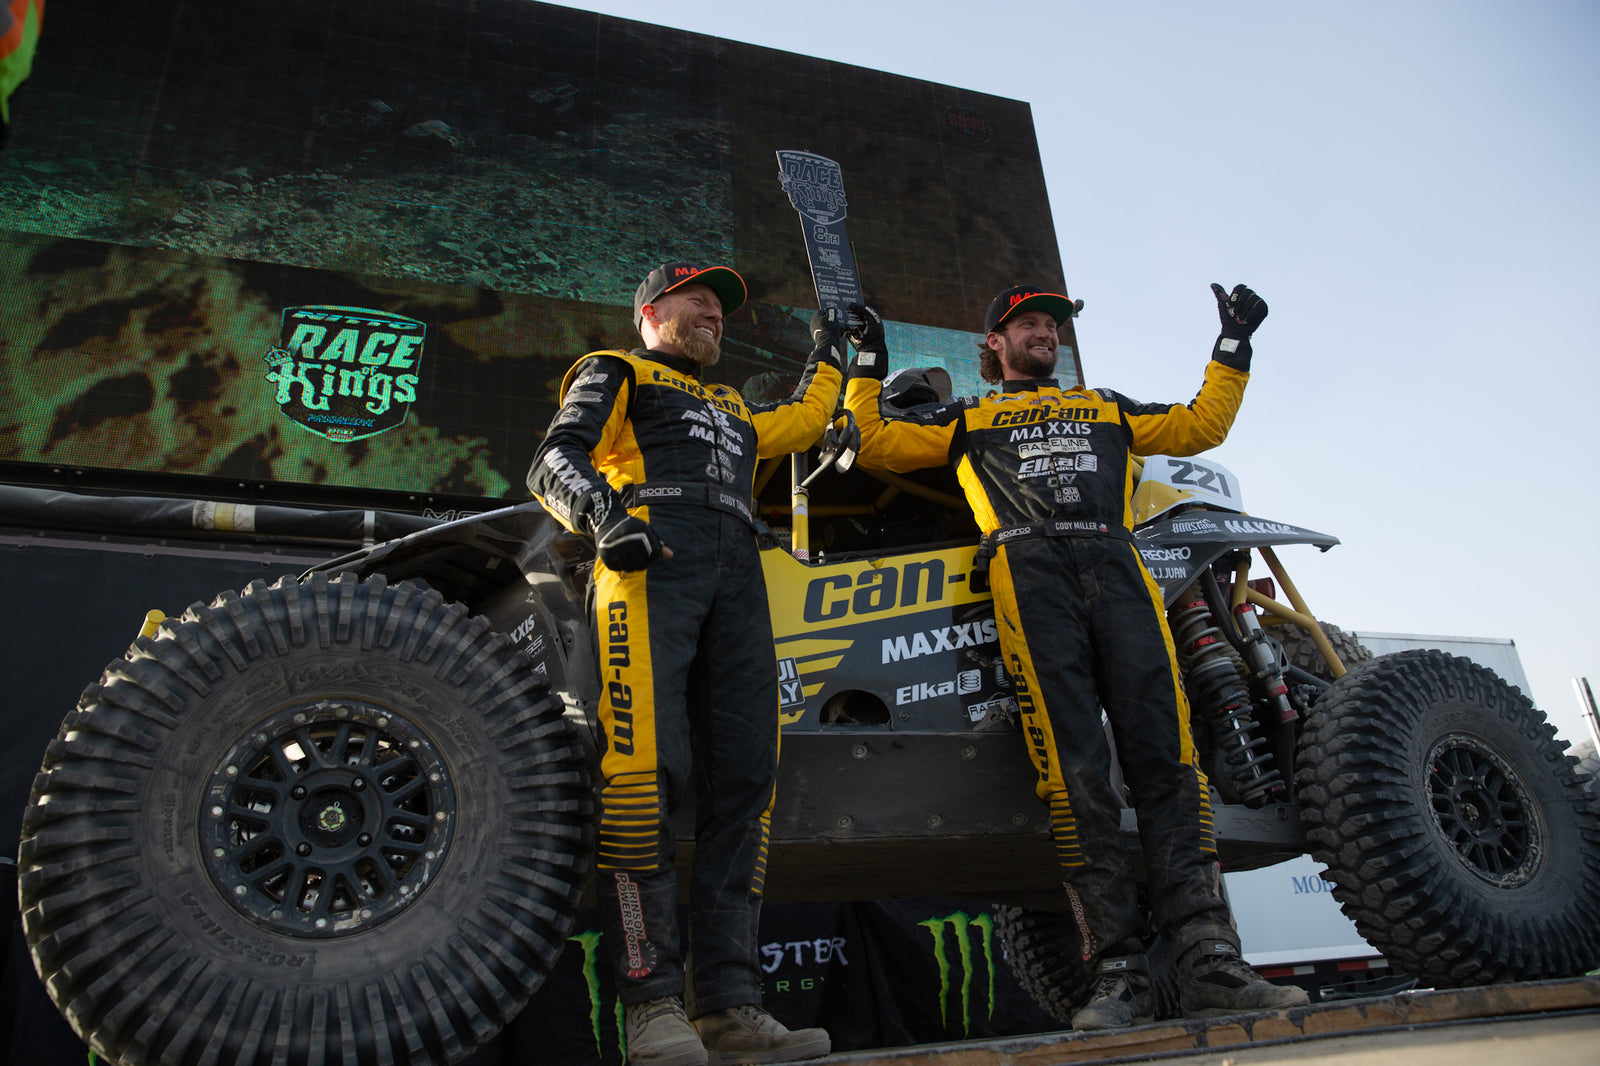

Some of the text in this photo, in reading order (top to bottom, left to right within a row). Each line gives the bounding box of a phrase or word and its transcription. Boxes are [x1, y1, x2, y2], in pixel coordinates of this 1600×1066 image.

[785, 159, 841, 188] RACE
[813, 224, 840, 246] 8TH
[674, 266, 704, 278] MA
[1009, 291, 1037, 306] MA
[287, 323, 424, 369] RACE
[265, 360, 419, 415] Kings
[991, 403, 1099, 428] can-am
[688, 424, 744, 457] MAXXIS
[1009, 421, 1092, 443] MAXXIS
[1020, 438, 1089, 453] RACELINE
[1018, 457, 1074, 475] Elka
[1167, 459, 1232, 498] 221
[639, 487, 682, 498] sparco
[998, 526, 1031, 541] sparco
[1055, 521, 1098, 531] CODY MILLER
[1224, 519, 1299, 535] MAXXIS
[1139, 547, 1192, 561] RECARO
[881, 618, 998, 665] MAXXIS
[608, 600, 635, 757] can-am
[896, 680, 955, 706] Elka
[1291, 875, 1338, 895] MOB
[615, 872, 642, 969] POWERSPORTS
[626, 882, 647, 940] BRINSON
